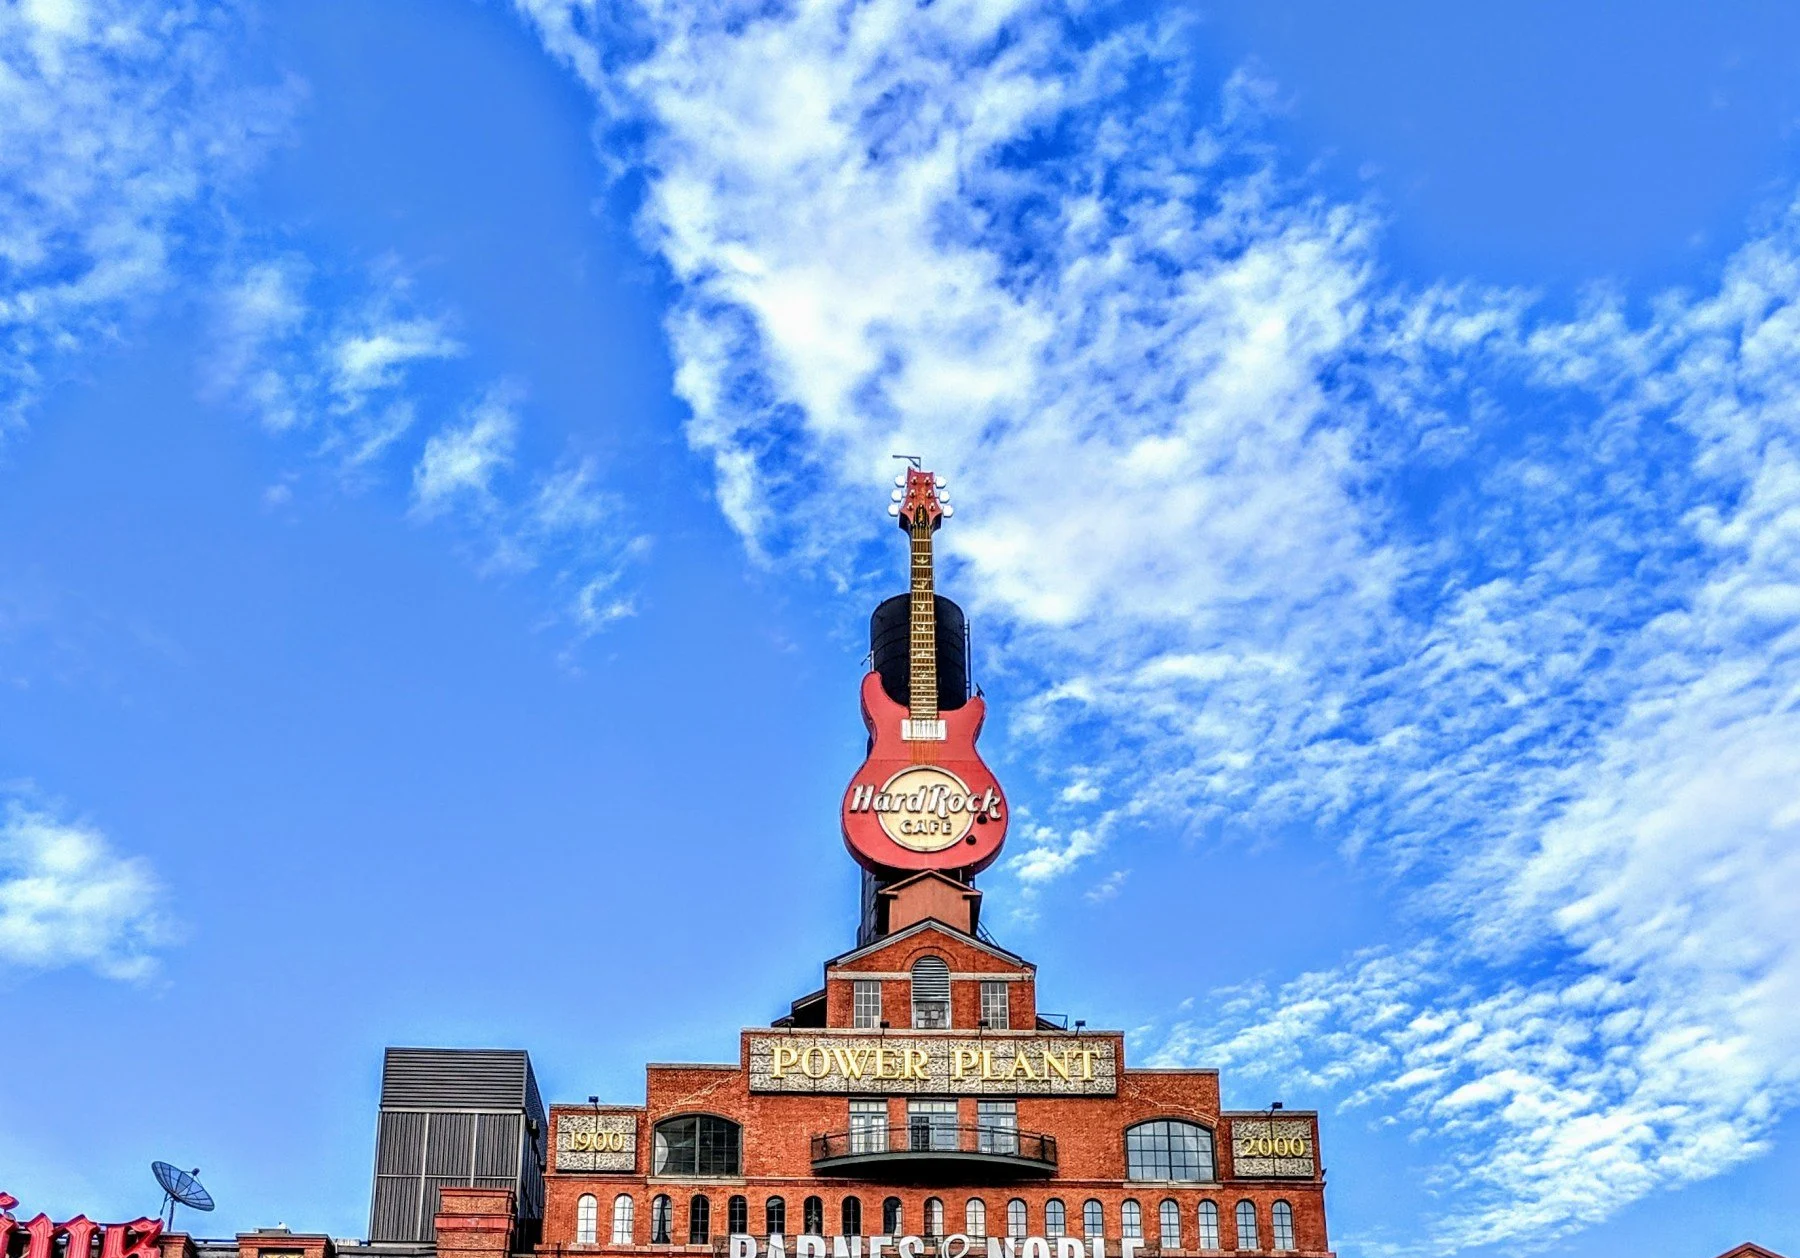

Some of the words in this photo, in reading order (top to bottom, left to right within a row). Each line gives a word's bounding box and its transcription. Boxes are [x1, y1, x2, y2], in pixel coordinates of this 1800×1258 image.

[850, 784, 928, 813] Hard
[928, 784, 1001, 820] Rock
[899, 820, 953, 835] CAFE
[771, 1046, 931, 1081] POWER
[952, 1047, 1101, 1082] PLANT
[567, 1130, 623, 1152] 1900
[1240, 1136, 1305, 1157] 2000
